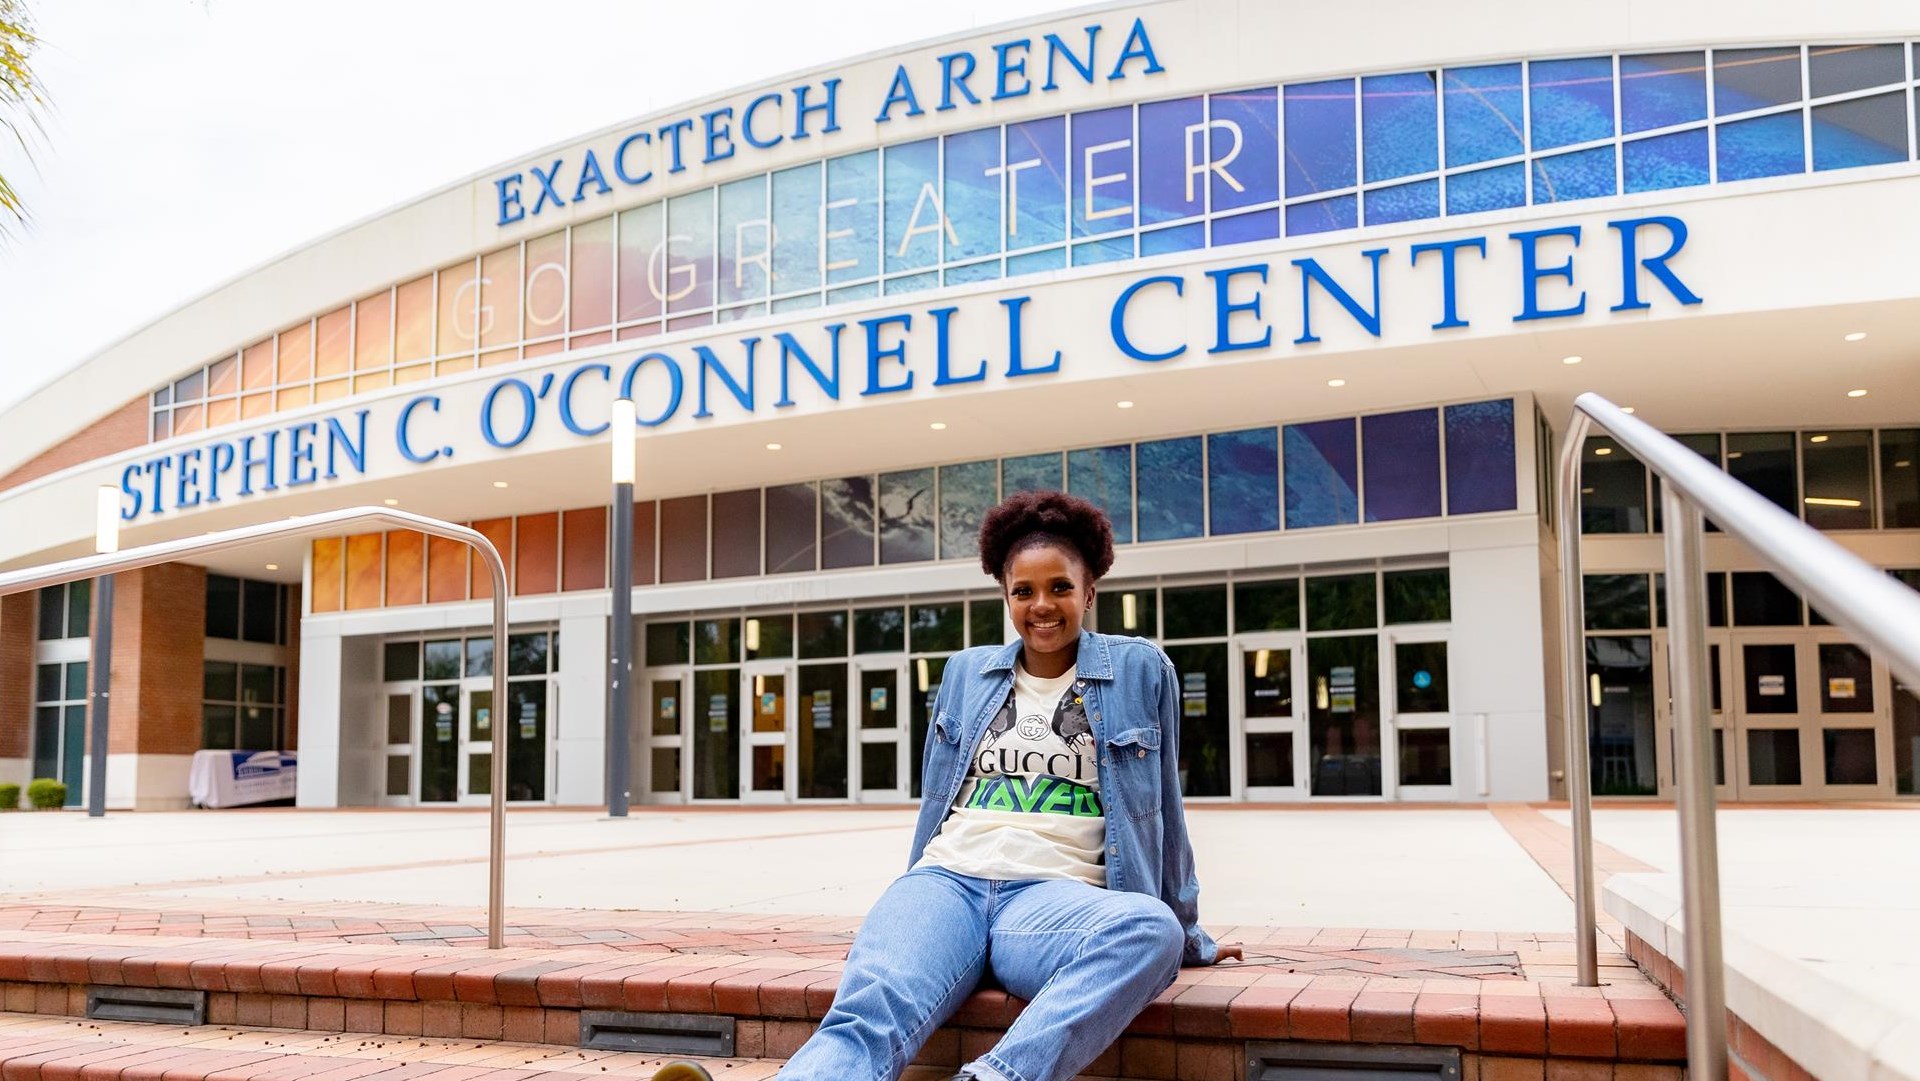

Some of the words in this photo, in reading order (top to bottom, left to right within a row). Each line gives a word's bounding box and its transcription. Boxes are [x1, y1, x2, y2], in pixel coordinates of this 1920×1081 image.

[451, 259, 572, 342] GO
[647, 117, 1246, 304] GREATER
[495, 76, 845, 227] EXACTECH
[874, 16, 1166, 124] ARENA
[120, 408, 369, 521] STEPHEN
[394, 395, 455, 465] C.
[479, 295, 1063, 449] O'CONNELL
[1110, 215, 1705, 363] CENTER
[978, 748, 1083, 781] GUCCI
